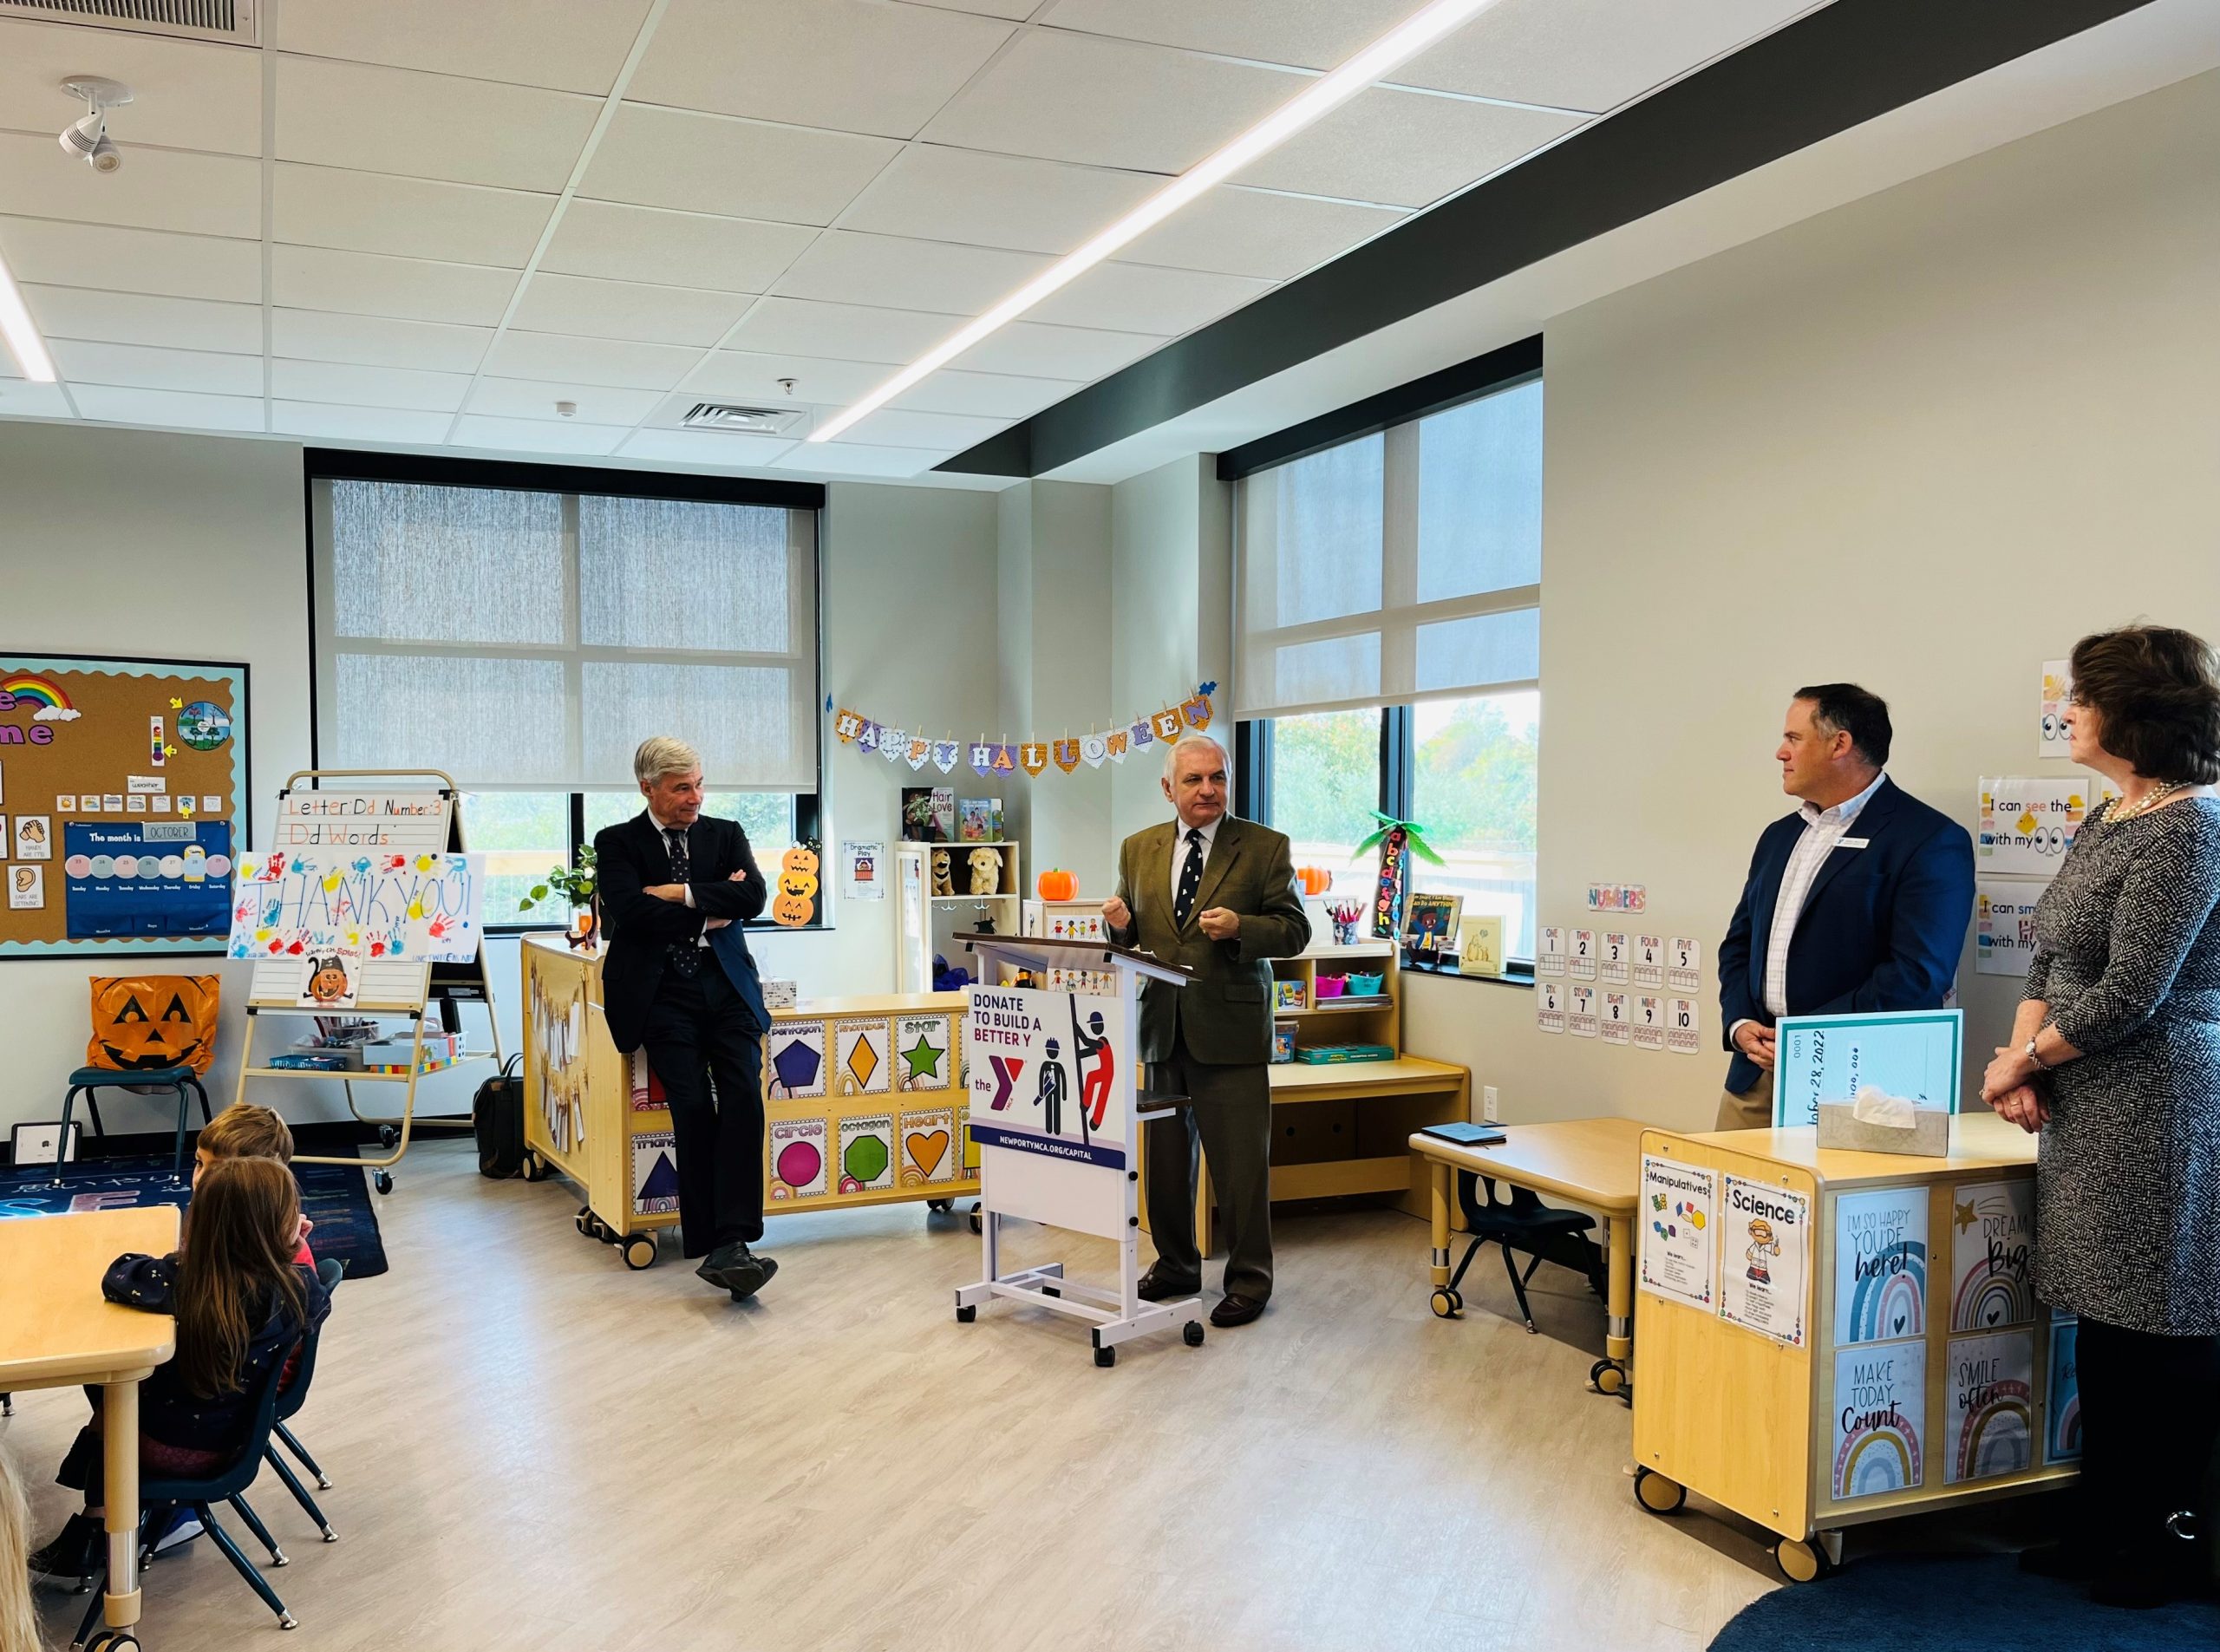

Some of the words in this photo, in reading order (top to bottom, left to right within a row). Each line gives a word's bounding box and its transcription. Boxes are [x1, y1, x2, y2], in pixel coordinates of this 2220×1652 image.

[837, 715, 956, 764] HAPPY
[972, 700, 1210, 770] HALLOWEEN
[932, 803, 952, 813] Love
[933, 791, 952, 802] Hair
[1990, 799, 1995, 813] I
[1999, 801, 2021, 813] can
[2025, 801, 2047, 813] see
[2051, 800, 2072, 813] the
[89, 833, 106, 842] The
[108, 833, 132, 842] month
[134, 833, 140, 842] is
[150, 826, 189, 839] OCTOBER
[1985, 833, 2011, 846] with
[2014, 834, 2033, 850] my
[242, 874, 388, 929] THANK
[1589, 888, 1646, 910] NUMBERS
[1983, 901, 1988, 913] I
[1992, 904, 2014, 914] can
[1546, 928, 1558, 938] ONE
[1577, 930, 1590, 940] TWO
[1607, 934, 1624, 944] THREE
[1641, 937, 1659, 948] FOUR
[1677, 939, 1692, 950] FIVE
[1988, 935, 2014, 948] with
[2018, 937, 2037, 951] my
[1579, 942, 1586, 955] 2
[1611, 945, 1618, 960] 3
[1645, 949, 1652, 963] 4
[1681, 951, 1688, 966] 5
[974, 994, 1023, 1012] DONATE
[1545, 983, 1557, 994] SIX
[1574, 987, 1593, 998] SEVEN
[1607, 993, 1624, 1004] EIGHT
[1642, 997, 1656, 1009] NINE
[1677, 1000, 1689, 1011] TEN
[974, 1011, 990, 1025] TO
[994, 1013, 1029, 1030] BUILD
[1032, 1017, 1041, 1031] A
[1548, 996, 1555, 1009] 6
[1580, 998, 1586, 1012] 7
[1613, 1005, 1619, 1019] 8
[1646, 1009, 1652, 1023] 9
[1678, 1012, 1689, 1027] 10
[904, 1020, 941, 1035] Star
[974, 1028, 1019, 1046] BETTER
[1022, 1033, 1031, 1048] Y
[1793, 1035, 1802, 1059] 0001
[1812, 1030, 1825, 1064] 2022
[975, 1078, 991, 1093] the
[1005, 1097, 1014, 1111] YMCA
[774, 1124, 822, 1139] Circle
[904, 1113, 950, 1129] Heart
[999, 1134, 1093, 1160] NEWPORTYMCA.ORG/CAPITAL
[1649, 1172, 1708, 1196] Manipulatives
[1733, 1189, 1795, 1224] Science
[1863, 1212, 1877, 1231] SO
[1878, 1209, 1910, 1227] HAPPY
[1983, 1214, 2028, 1238] DREAM
[1851, 1225, 1905, 1255] YOU'RE
[1987, 1236, 2032, 1283] Big
[1854, 1360, 1894, 1386] MAKE
[1958, 1357, 2001, 1388] SMILE
[1851, 1384, 1896, 1408] TODAY
[1958, 1382, 2004, 1414] often
[1841, 1400, 1902, 1434] Count
